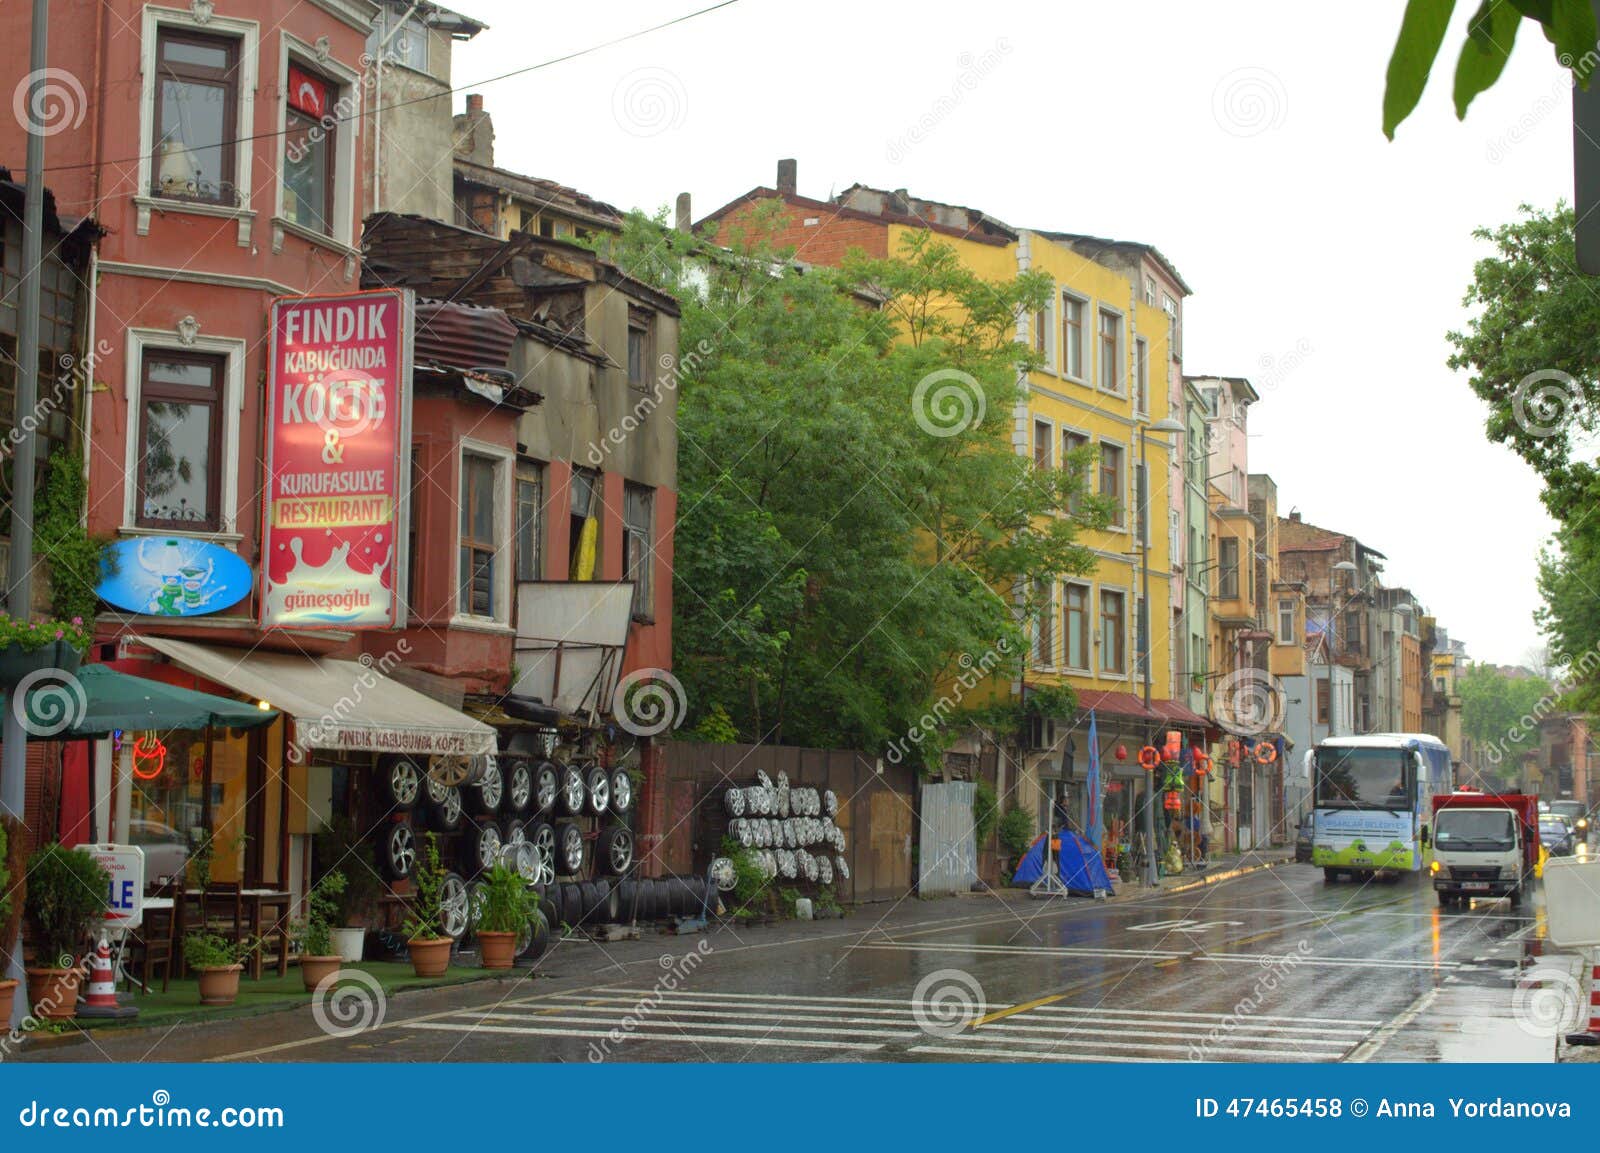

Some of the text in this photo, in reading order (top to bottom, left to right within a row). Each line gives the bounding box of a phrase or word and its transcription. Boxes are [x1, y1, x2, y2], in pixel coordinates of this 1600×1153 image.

[285, 304, 388, 346] FINDIK
[284, 344, 387, 374] KABUĞUNDA
[282, 373, 386, 424] KÖFTE
[321, 428, 345, 465] &
[280, 470, 385, 496] KURUFASULYE
[279, 500, 384, 524] RESTAURANT
[284, 588, 370, 613] güneşoğlu
